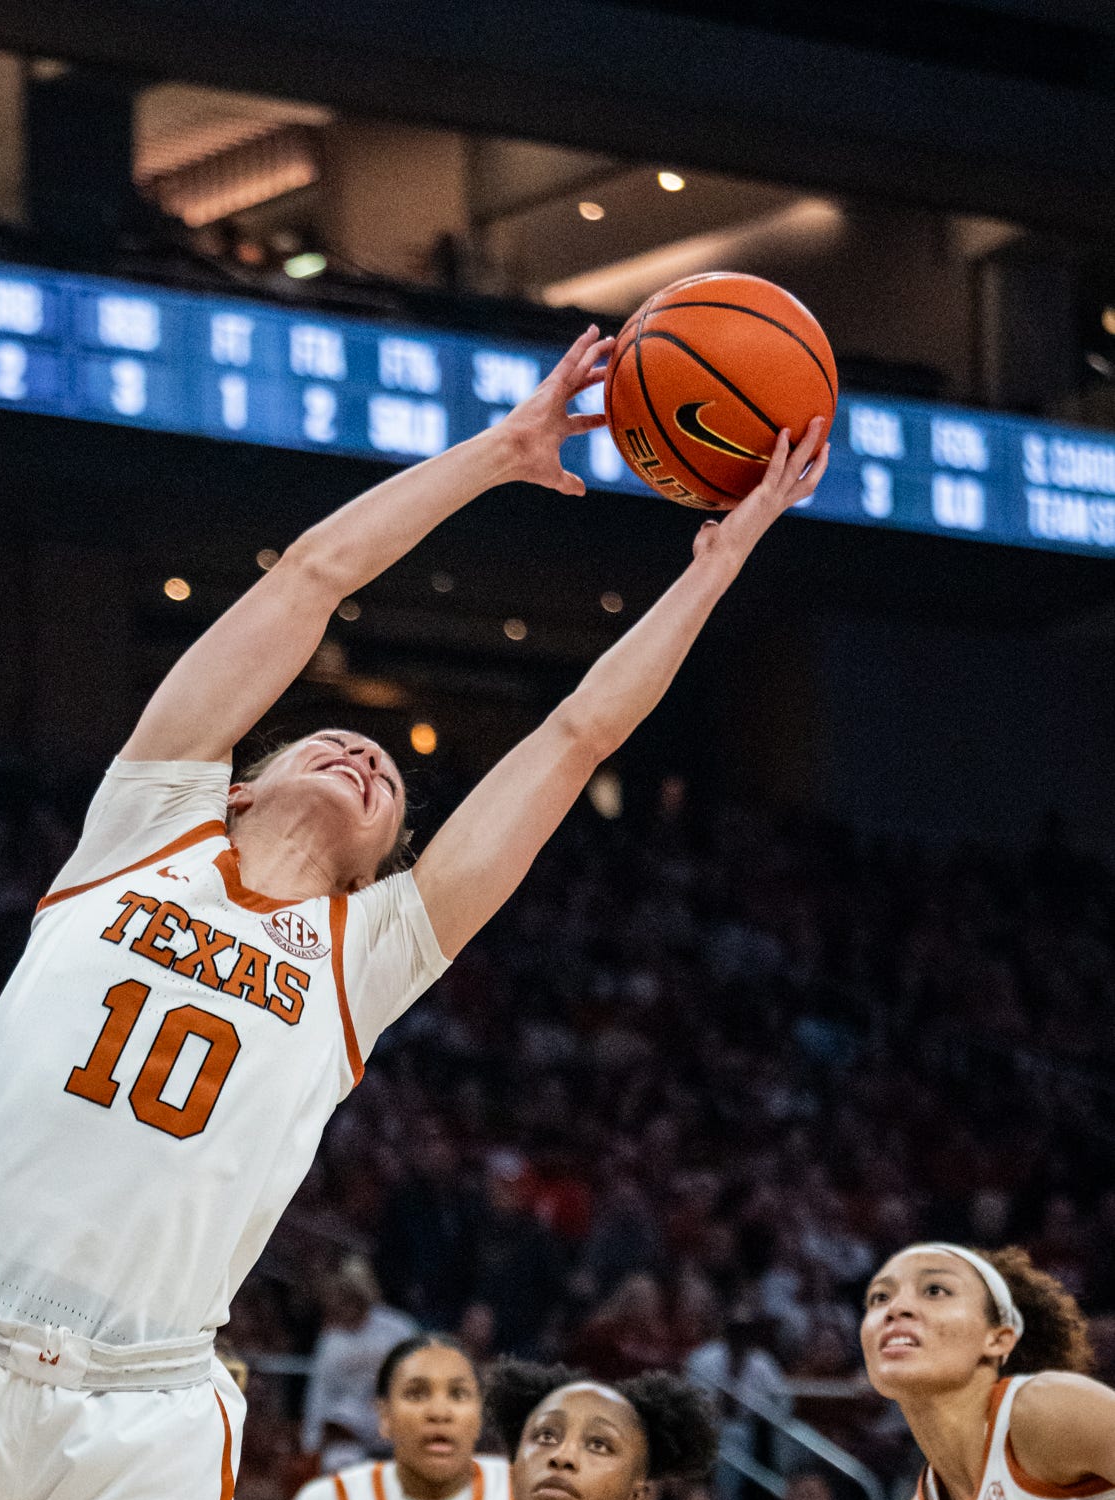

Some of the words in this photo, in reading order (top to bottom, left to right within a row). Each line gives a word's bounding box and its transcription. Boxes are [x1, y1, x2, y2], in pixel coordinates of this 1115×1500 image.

[100, 890, 312, 1027] TEXAS
[273, 911, 318, 948] SEC
[64, 978, 242, 1141] 10
